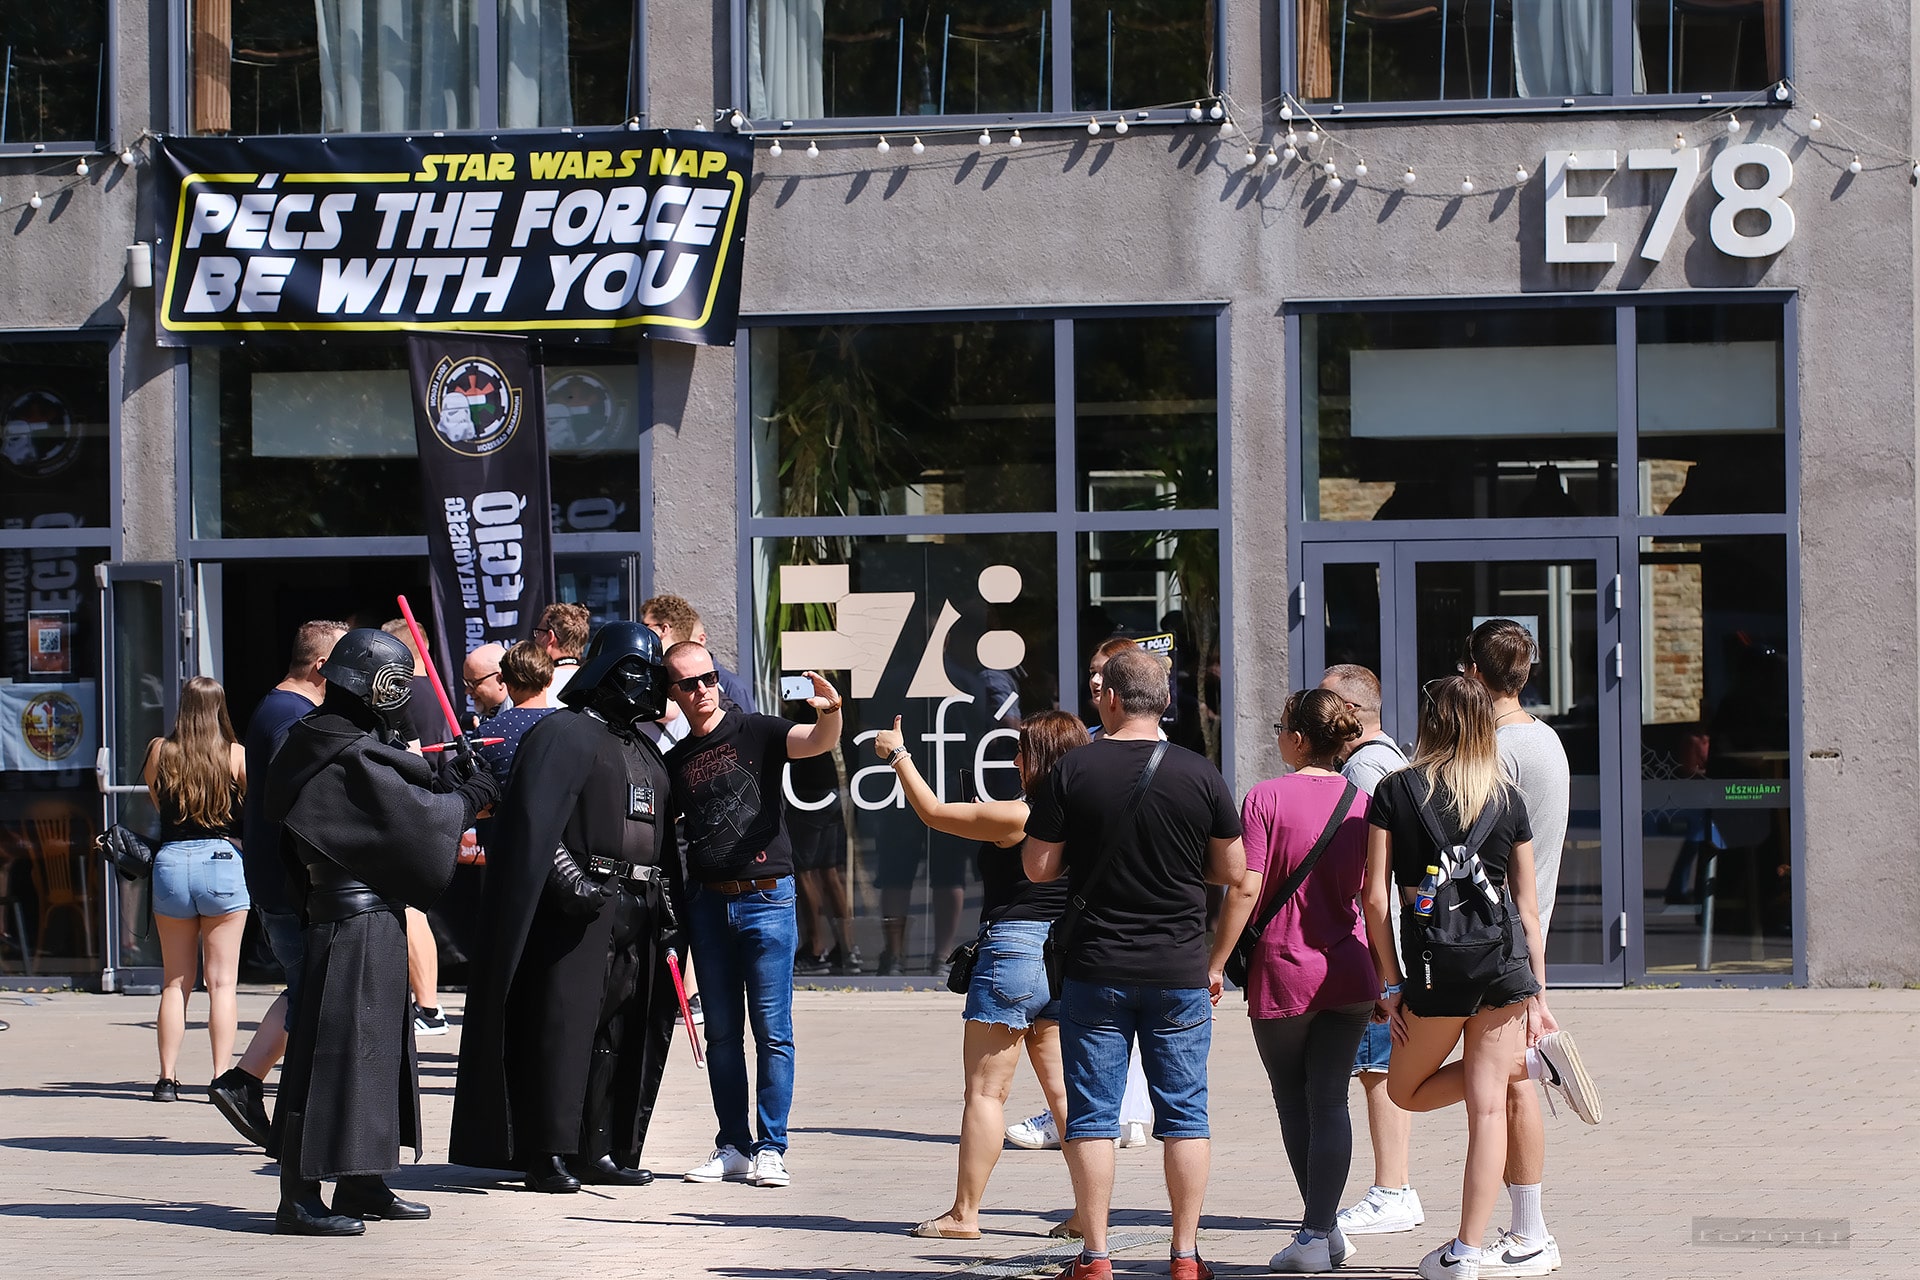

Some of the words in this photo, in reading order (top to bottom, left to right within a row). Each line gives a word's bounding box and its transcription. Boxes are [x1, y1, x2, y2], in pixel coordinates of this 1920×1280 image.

[414, 153, 515, 181] STAR
[529, 149, 642, 180] WARS
[649, 148, 728, 179] NAP
[185, 173, 357, 250] PÉCS
[374, 191, 504, 249] THE
[510, 185, 732, 248] FORCE
[1545, 143, 1796, 263] E78
[183, 256, 297, 314] BE
[316, 256, 522, 315] WITH
[545, 250, 700, 312] YOU
[780, 564, 1026, 699] E78
[1725, 784, 1781, 795] VÉSZKIJÁRAT
